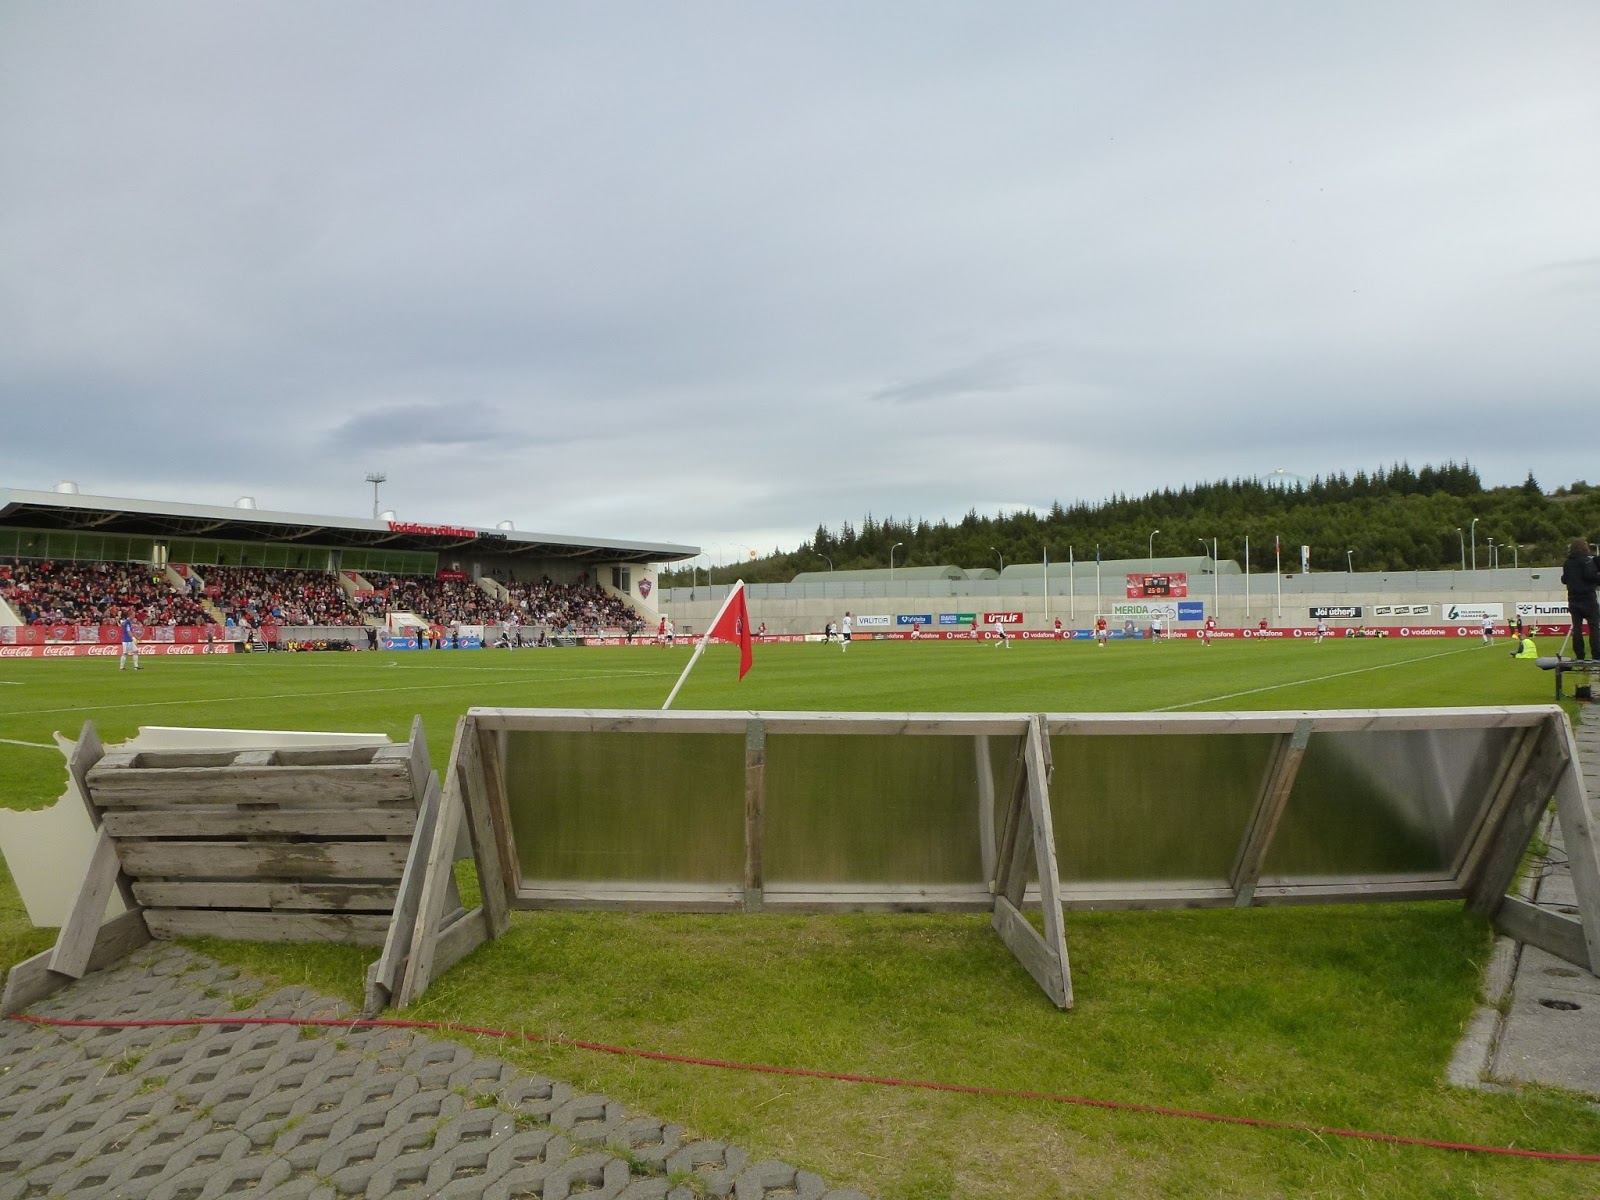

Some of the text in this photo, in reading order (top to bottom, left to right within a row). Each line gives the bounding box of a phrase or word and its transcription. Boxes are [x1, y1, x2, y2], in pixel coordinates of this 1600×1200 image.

[1115, 605, 1148, 614] MERIDA
[1534, 605, 1569, 614] humm
[988, 613, 1018, 622] ÚTILÍF
